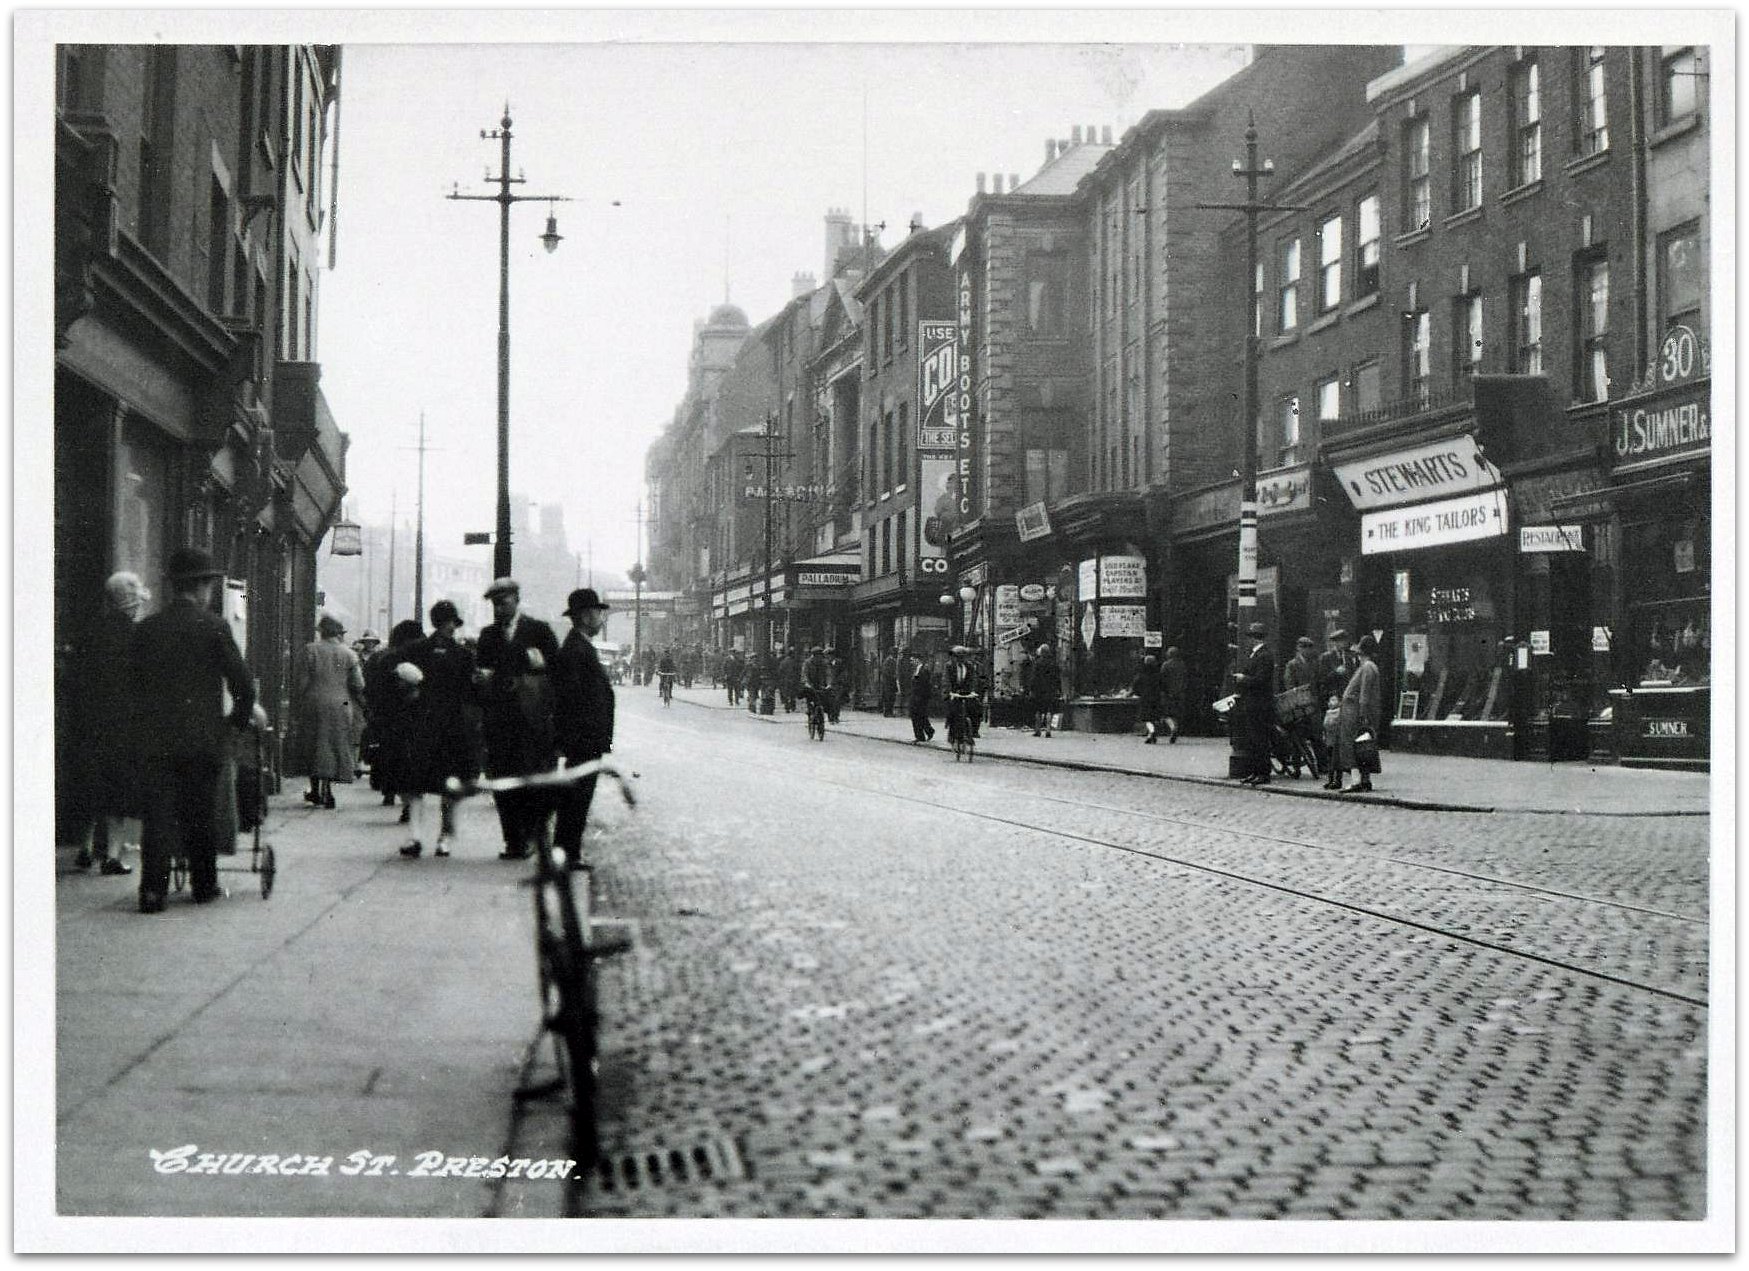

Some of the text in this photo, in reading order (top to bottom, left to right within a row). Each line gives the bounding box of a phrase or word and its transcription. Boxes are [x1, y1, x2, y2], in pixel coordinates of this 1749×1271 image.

[926, 327, 954, 339] USE
[1662, 333, 1693, 382] 30
[960, 271, 971, 513] ARMY BOOTS ETC
[1363, 452, 1469, 494] STEWARTS
[745, 485, 836, 499] PALADIUM
[1378, 505, 1487, 540] THE KING TAILORS
[922, 559, 948, 573] CO
[801, 573, 850, 584] PALLADIUM
[1650, 721, 1688, 735] SUMNER
